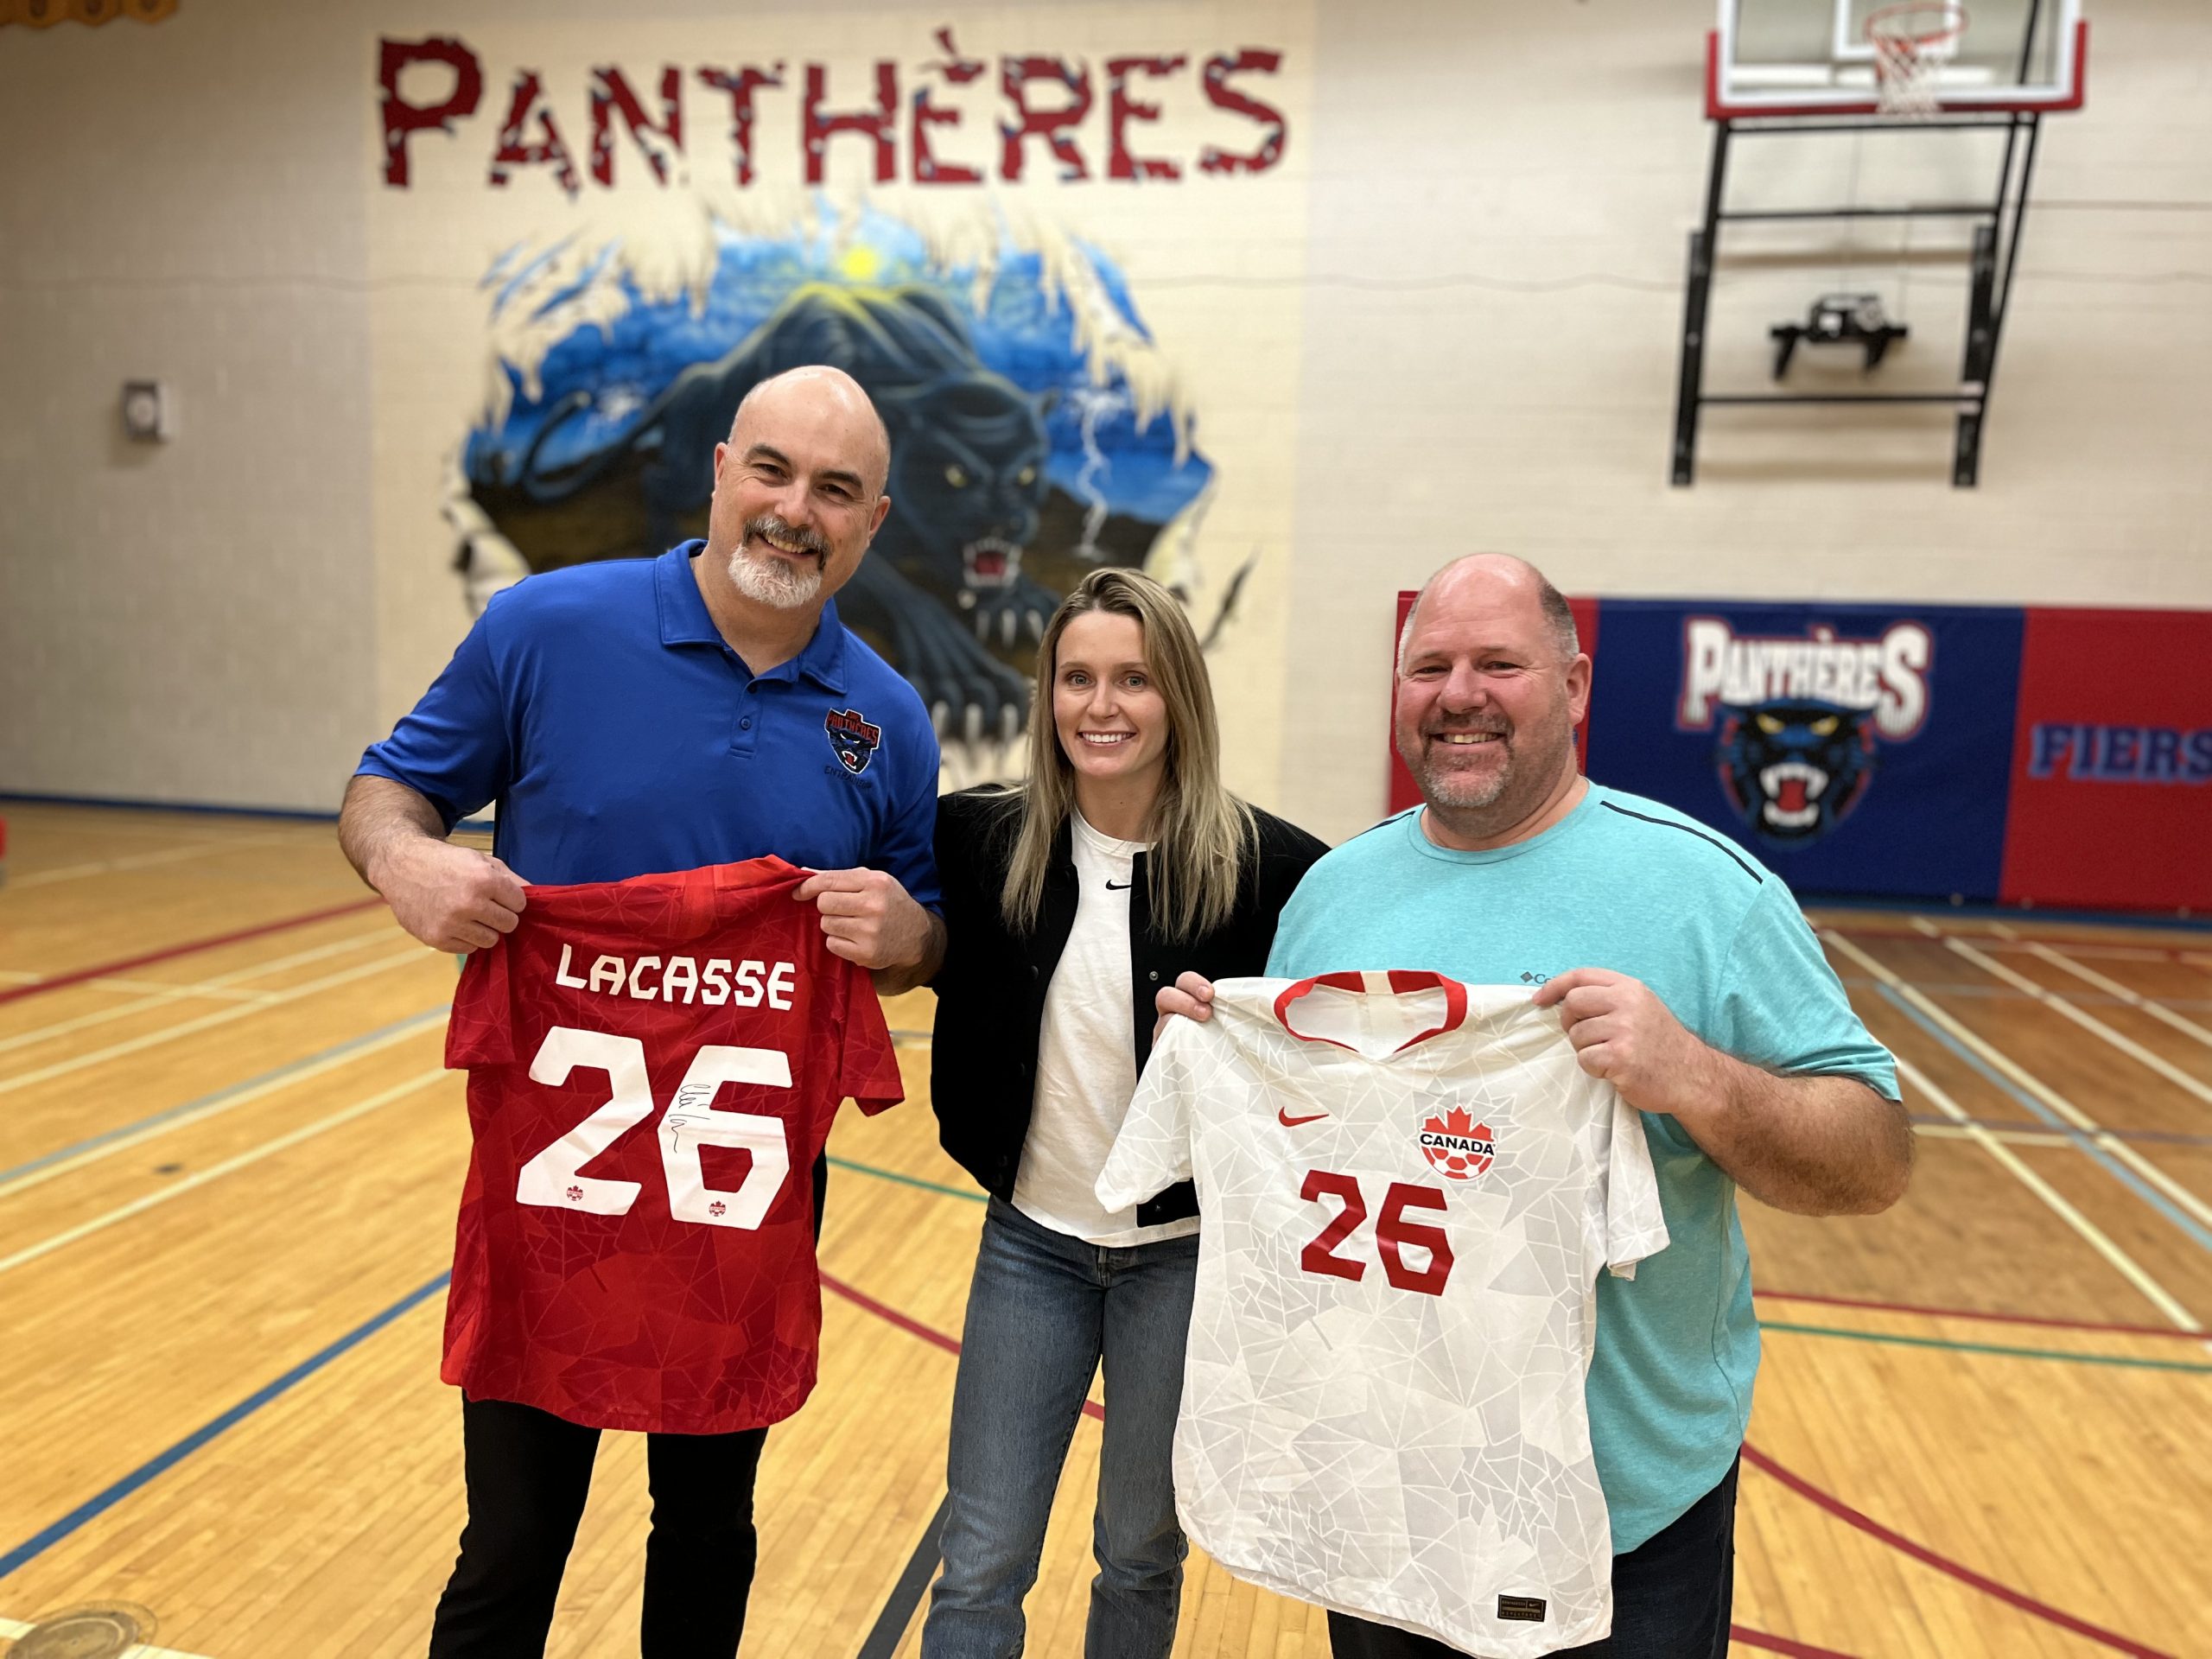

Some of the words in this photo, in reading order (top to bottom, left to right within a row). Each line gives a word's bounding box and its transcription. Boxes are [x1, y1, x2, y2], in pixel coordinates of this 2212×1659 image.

[378, 28, 1287, 203] PANTHÈRES
[1680, 617, 1932, 739] PANTHÈRES
[556, 944, 795, 1010] LACASSE
[516, 1026, 792, 1230] 26
[1420, 1134, 1494, 1156] CANADA
[1300, 1169, 1454, 1296] 26
